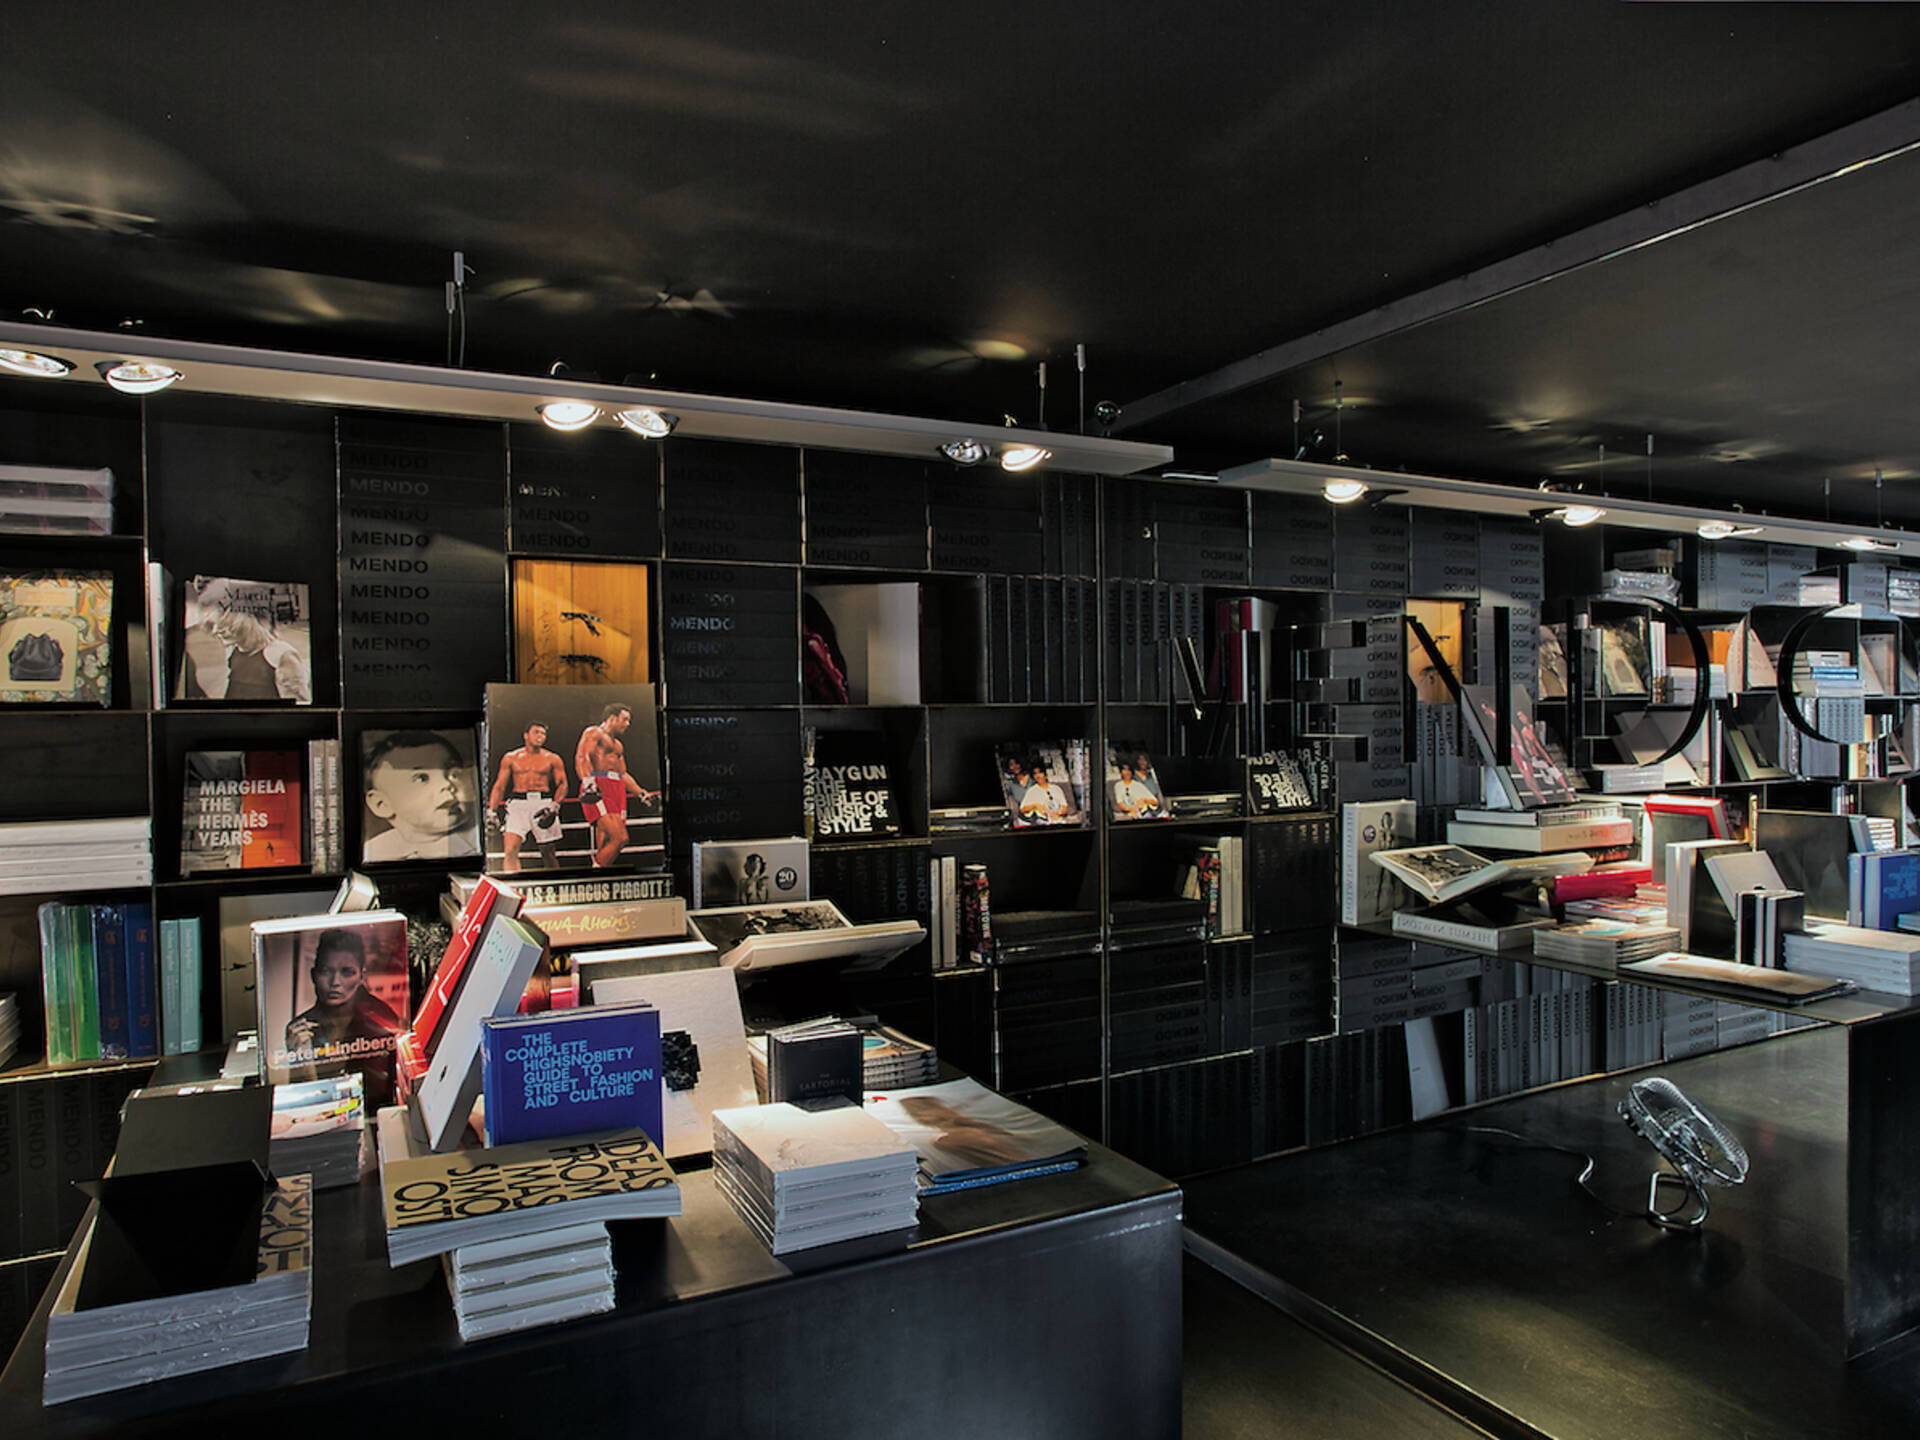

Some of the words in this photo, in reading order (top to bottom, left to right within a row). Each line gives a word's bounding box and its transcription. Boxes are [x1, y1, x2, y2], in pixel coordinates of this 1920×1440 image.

[350, 478, 430, 496] MENDO
[351, 507, 430, 522] MENDO
[519, 507, 590, 523] MENDO
[351, 531, 431, 549] MENDO
[520, 533, 591, 549] MENDO
[672, 541, 736, 556] MENDO
[350, 558, 429, 574] MENDO
[670, 568, 735, 584] MENDO
[351, 584, 430, 600] MENDO
[351, 610, 430, 626] MENDO
[670, 616, 735, 632] MENDO
[352, 636, 431, 652] MENDO
[1168, 598, 1920, 768] MENDO
[200, 779, 286, 795] MARGIELA
[200, 797, 231, 812] THE
[865, 790, 888, 805] OF
[199, 810, 268, 829] HERMÈS
[874, 804, 888, 818] &
[818, 817, 872, 835] STYLE
[199, 830, 253, 847] YEARS
[915, 851, 927, 912] MENDO
[545, 886, 558, 905] &
[559, 884, 610, 904] MARCUS
[612, 879, 664, 900] PIGGOTT
[522, 1032, 552, 1047] THE
[274, 1050, 321, 1064] Peter
[505, 1040, 588, 1062] COMPLETE
[523, 1046, 635, 1072] HIGHSNOBIETY
[523, 1067, 570, 1085] GUIDE
[581, 1063, 603, 1077] TO
[524, 1078, 579, 1097] STREET
[590, 1068, 653, 1088] FASHION
[524, 1095, 559, 1110] AND
[569, 1083, 634, 1103] CULTURE
[27, 1088, 46, 1170] MENDO
[550, 1142, 618, 1201] FROM
[599, 1136, 674, 1192] IDEAS
[447, 1163, 511, 1216] SIMO
[501, 1163, 568, 1210] MAS
[394, 1181, 454, 1229] OSTI
